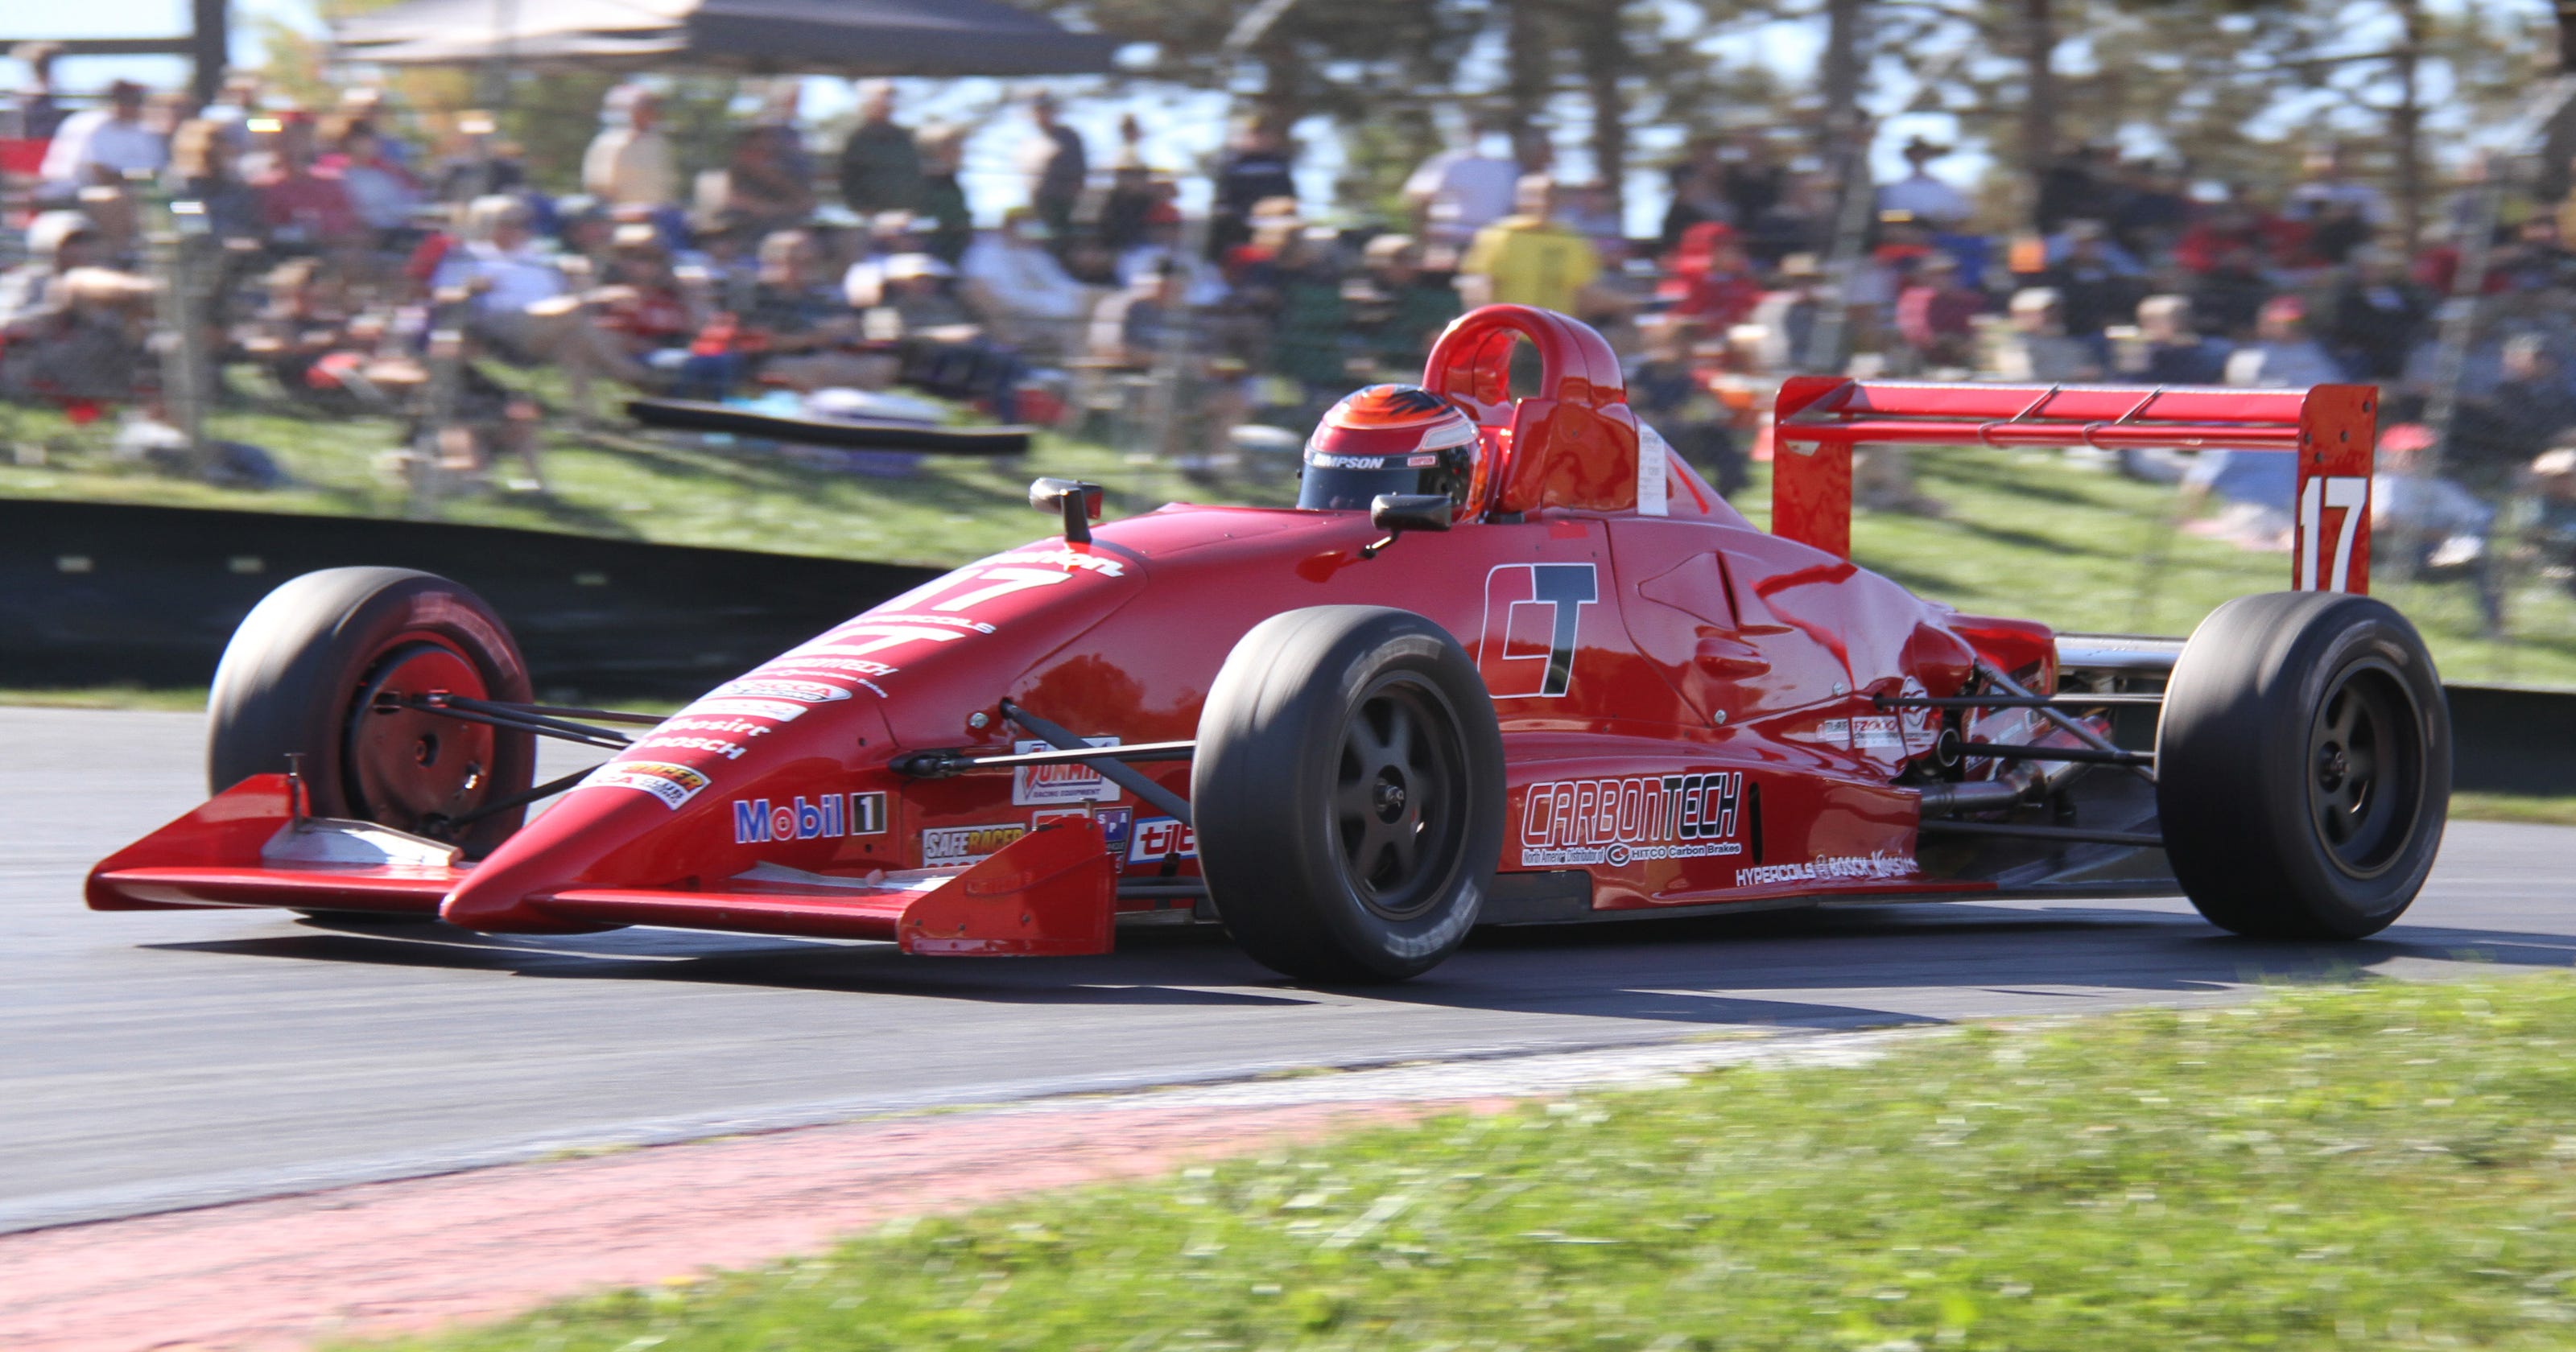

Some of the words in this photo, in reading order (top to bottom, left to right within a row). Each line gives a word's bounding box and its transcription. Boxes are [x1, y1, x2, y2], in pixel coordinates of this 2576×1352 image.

[1312, 453, 1385, 469] SIMPSON
[2300, 476, 2368, 593] 17
[876, 567, 1075, 612] 17
[733, 793, 845, 844] Mobil
[1521, 772, 1743, 847] CARBONTECH
[1631, 847, 1666, 859] HITCO
[1669, 844, 1705, 857] Carbon
[1707, 842, 1740, 854] Brakes
[1736, 862, 1817, 887] HYPERCOILS
[1828, 855, 1872, 877] BOSCH
